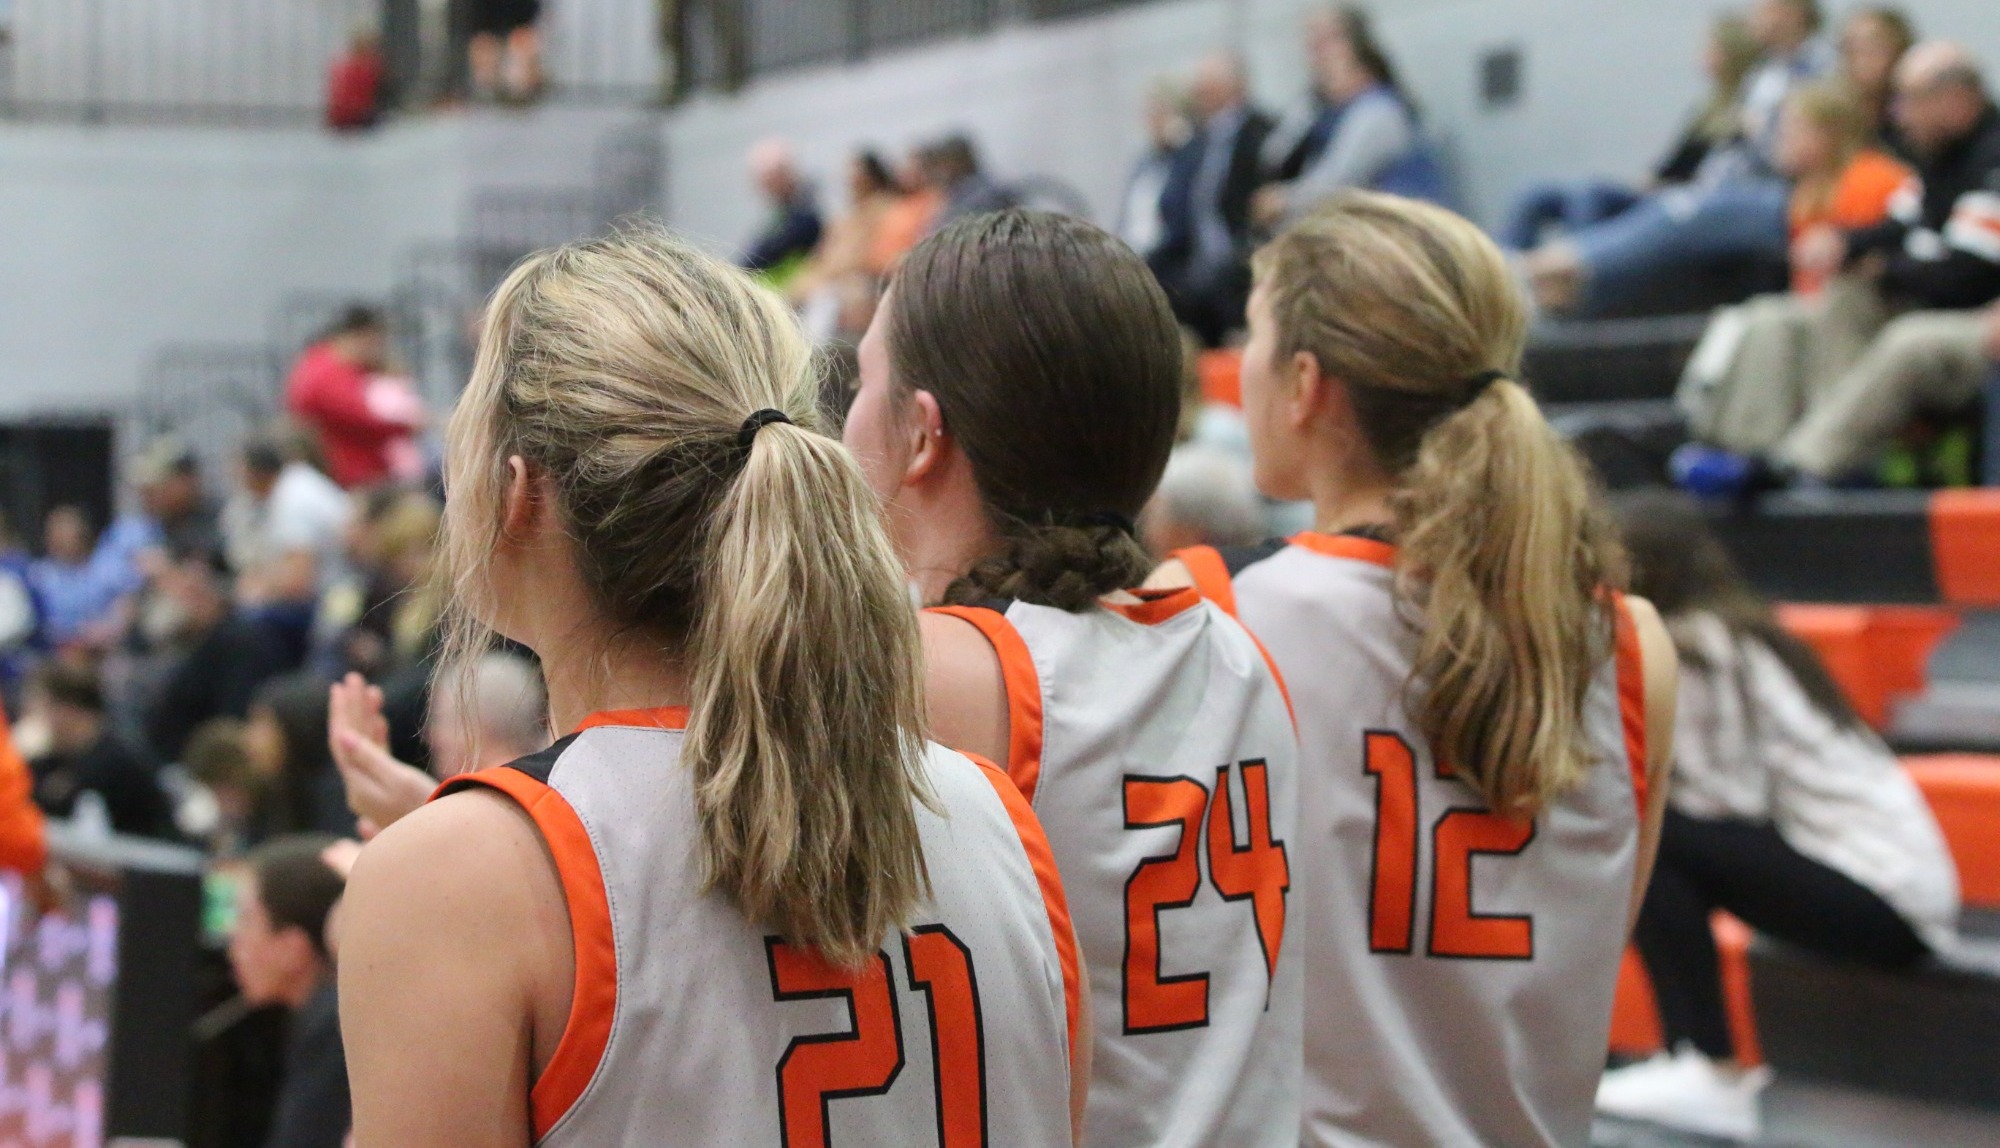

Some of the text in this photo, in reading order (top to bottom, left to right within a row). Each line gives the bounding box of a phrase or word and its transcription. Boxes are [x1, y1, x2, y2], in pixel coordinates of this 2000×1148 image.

[1122, 757, 1290, 1035] 24
[1363, 729, 1536, 960] 12
[764, 923, 989, 1148] 21
